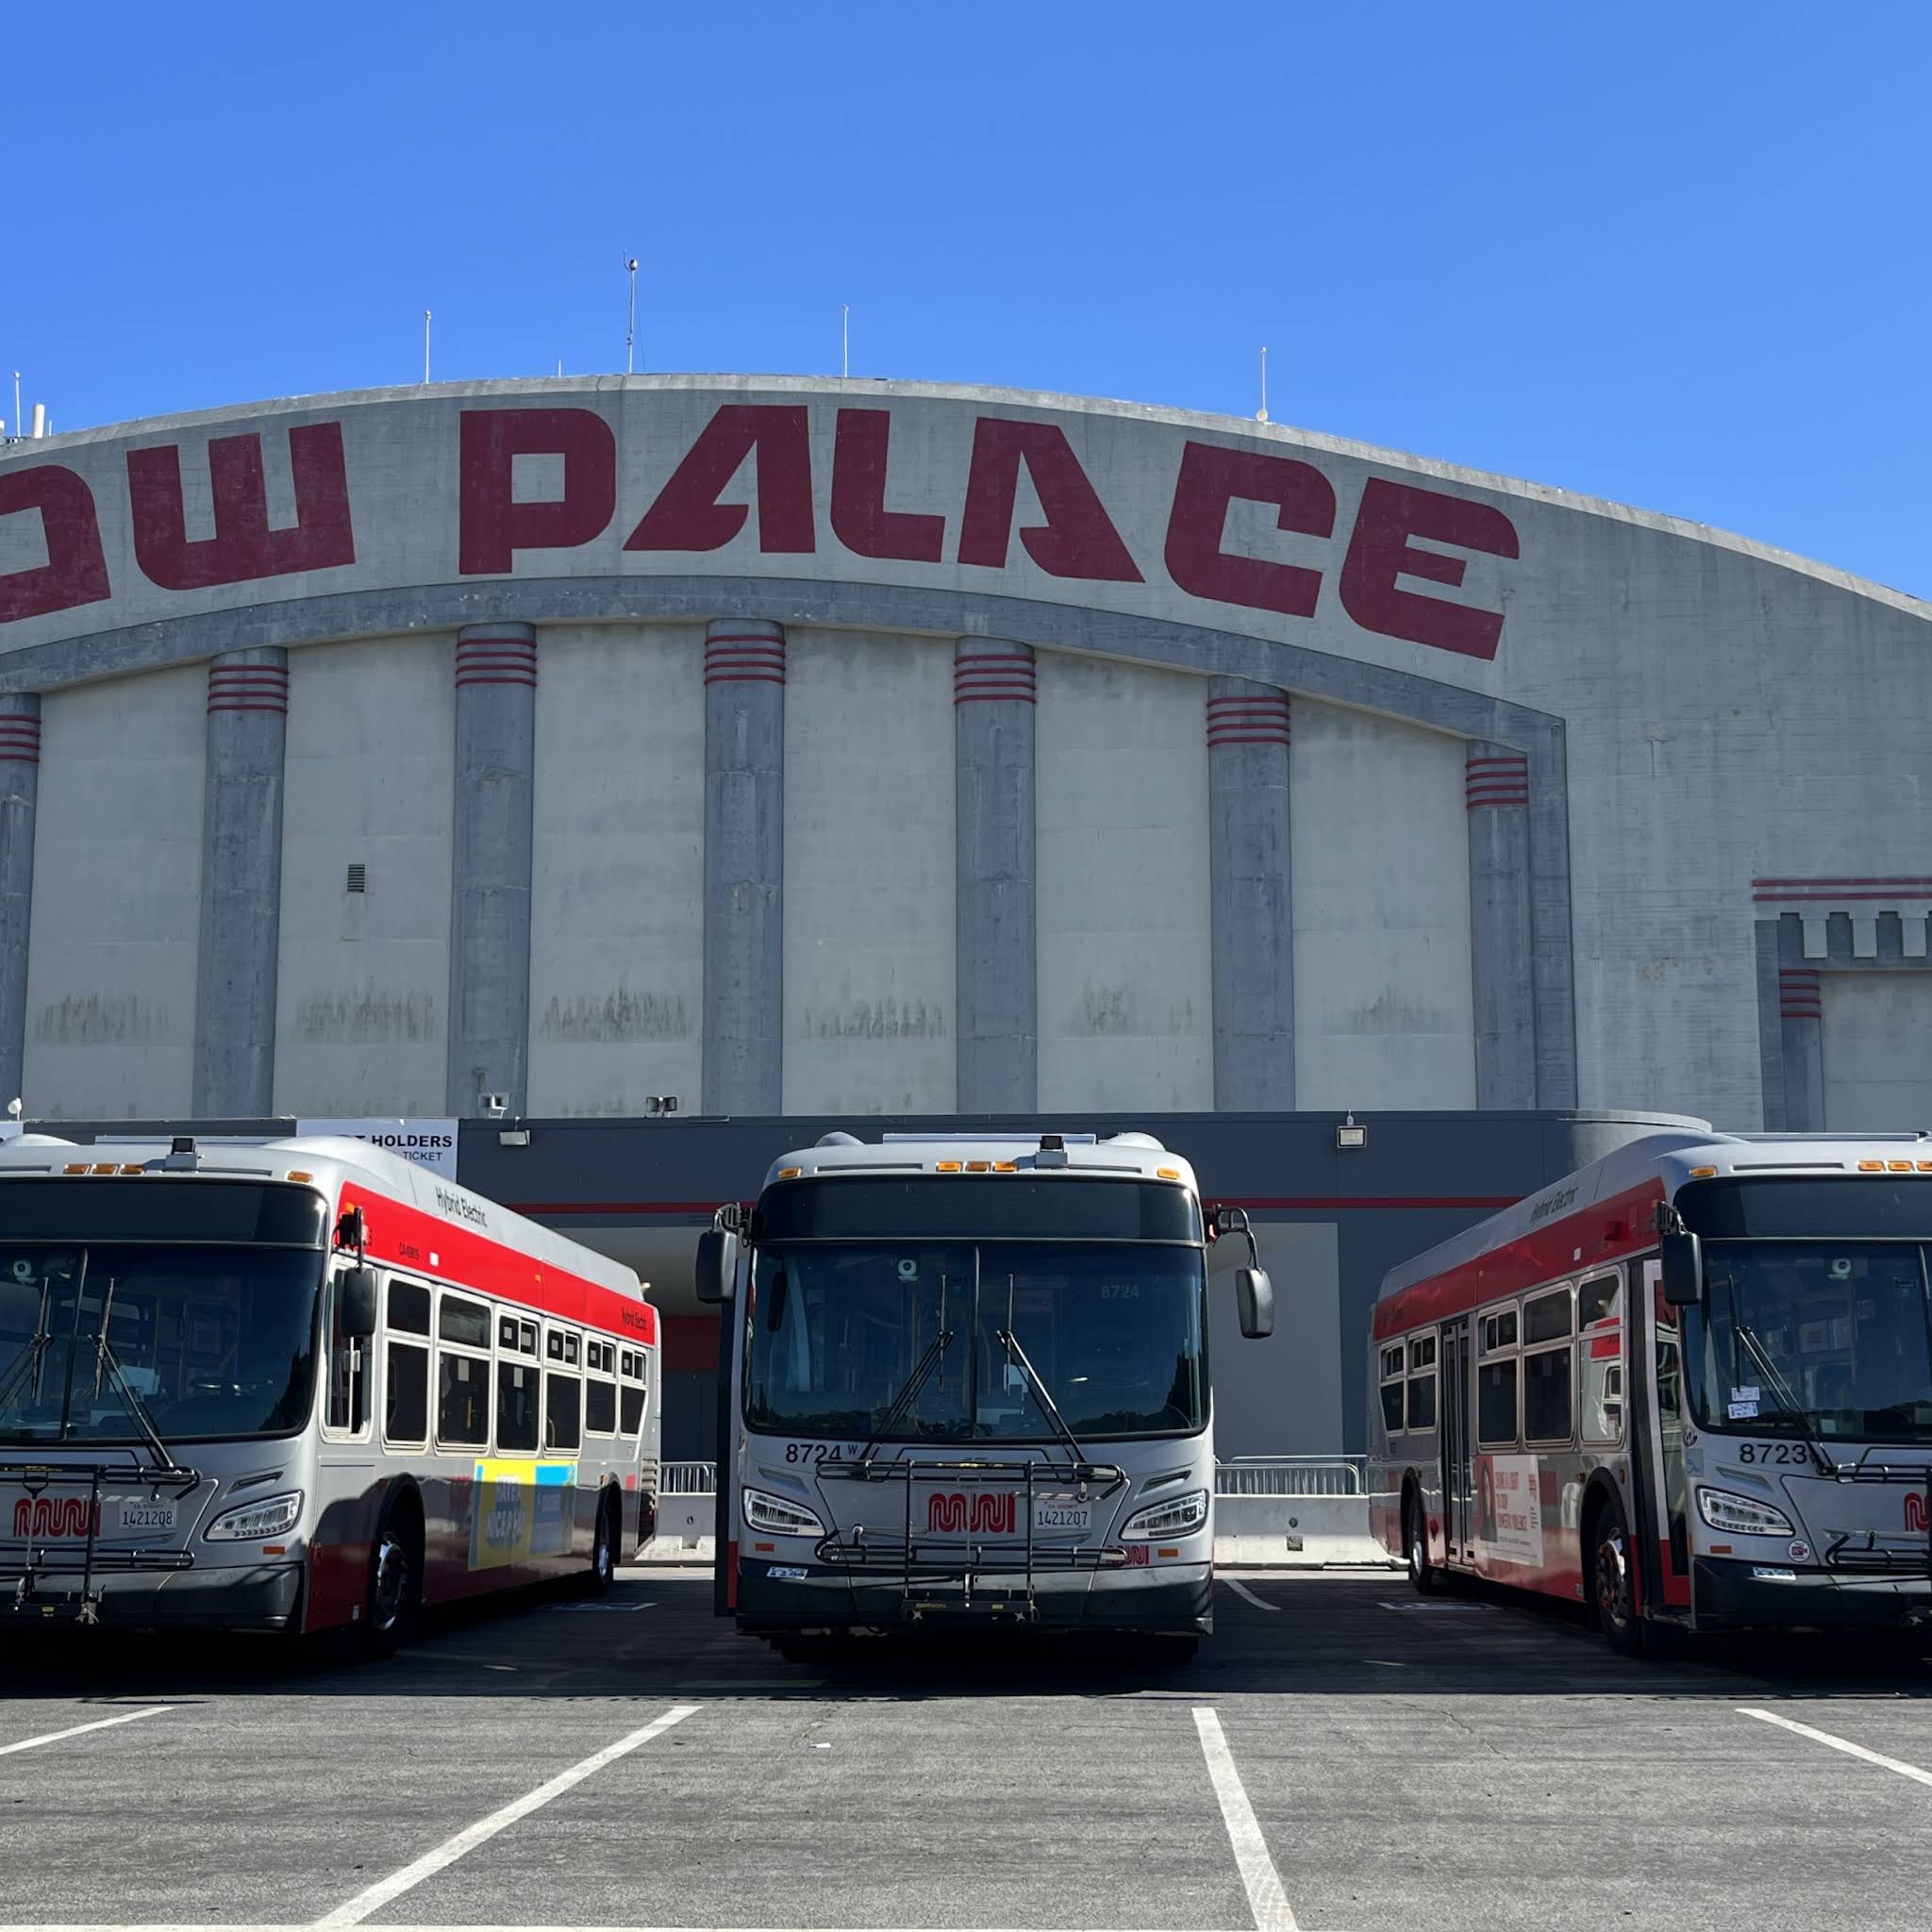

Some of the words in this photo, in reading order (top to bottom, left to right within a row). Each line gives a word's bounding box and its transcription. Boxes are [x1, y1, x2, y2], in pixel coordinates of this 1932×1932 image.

[459, 405, 1521, 661] PALACE
[372, 1135, 453, 1147] HOLDERS
[404, 1151, 443, 1161] TICKET
[435, 1186, 462, 1215] Hybrid
[461, 1197, 489, 1227] Electric
[1101, 1284, 1141, 1299] 8724
[786, 1443, 842, 1463] 8724
[1740, 1443, 1808, 1463] 8723
[123, 1510, 173, 1525] 1421208
[1038, 1510, 1088, 1525] 1421207
